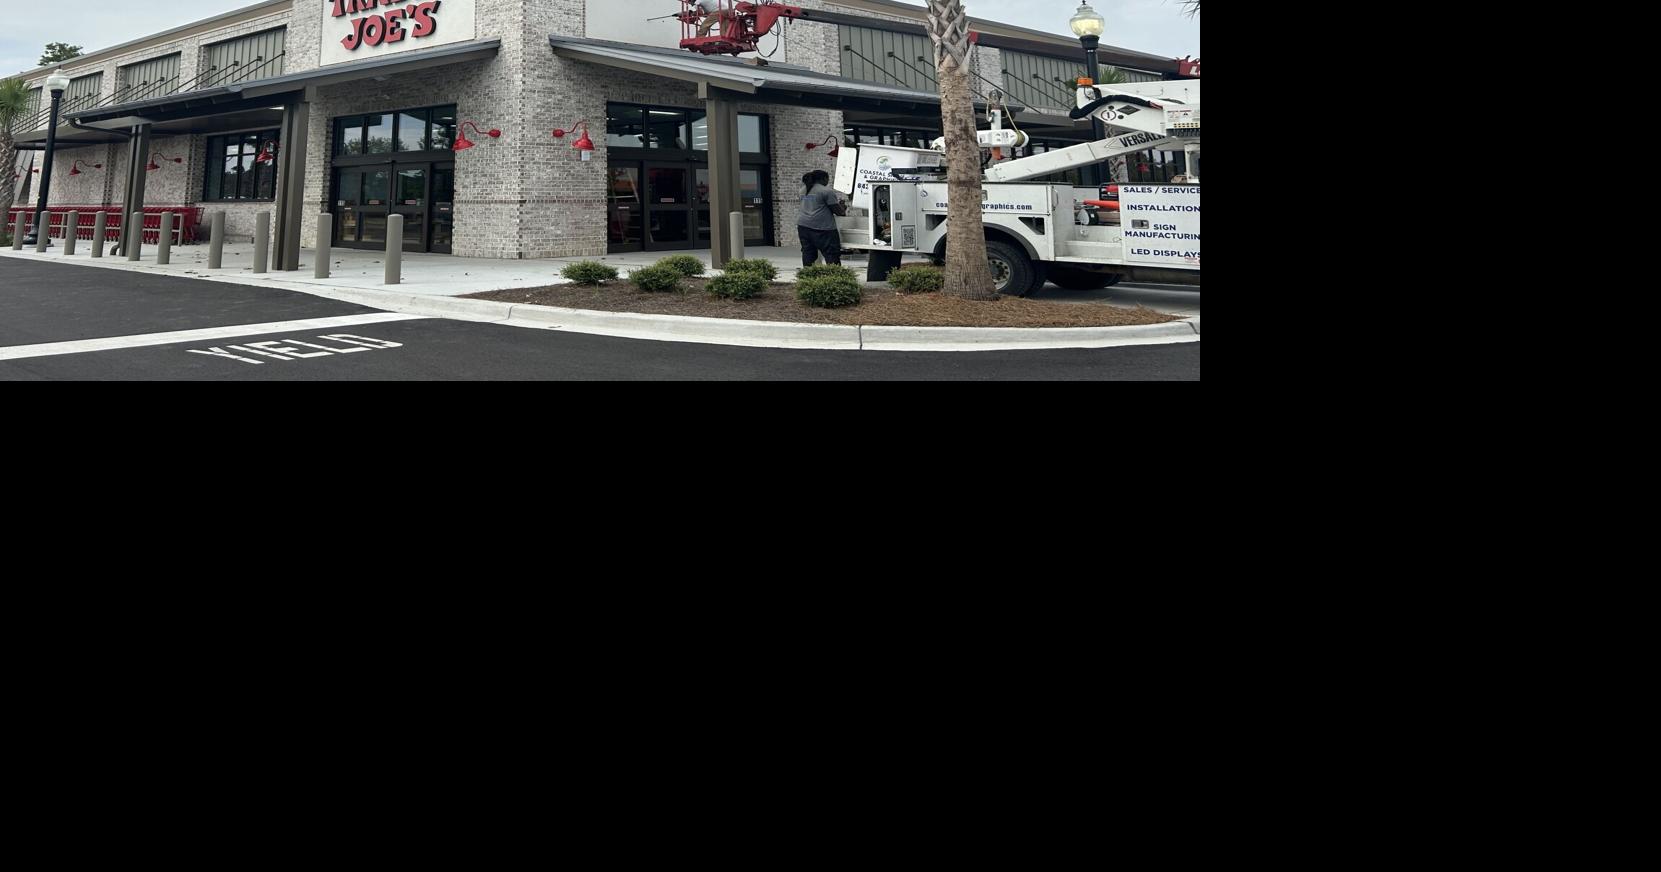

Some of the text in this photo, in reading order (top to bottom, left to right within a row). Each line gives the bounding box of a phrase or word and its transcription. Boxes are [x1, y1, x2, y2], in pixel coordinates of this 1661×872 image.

[340, 1, 441, 50] JOE'S
[859, 169, 886, 177] COASTAL
[1123, 186, 1153, 194] SALES
[1127, 204, 1200, 212] INSTALLATION
[1153, 223, 1177, 231] SIGN
[185, 333, 403, 364] YIELD
